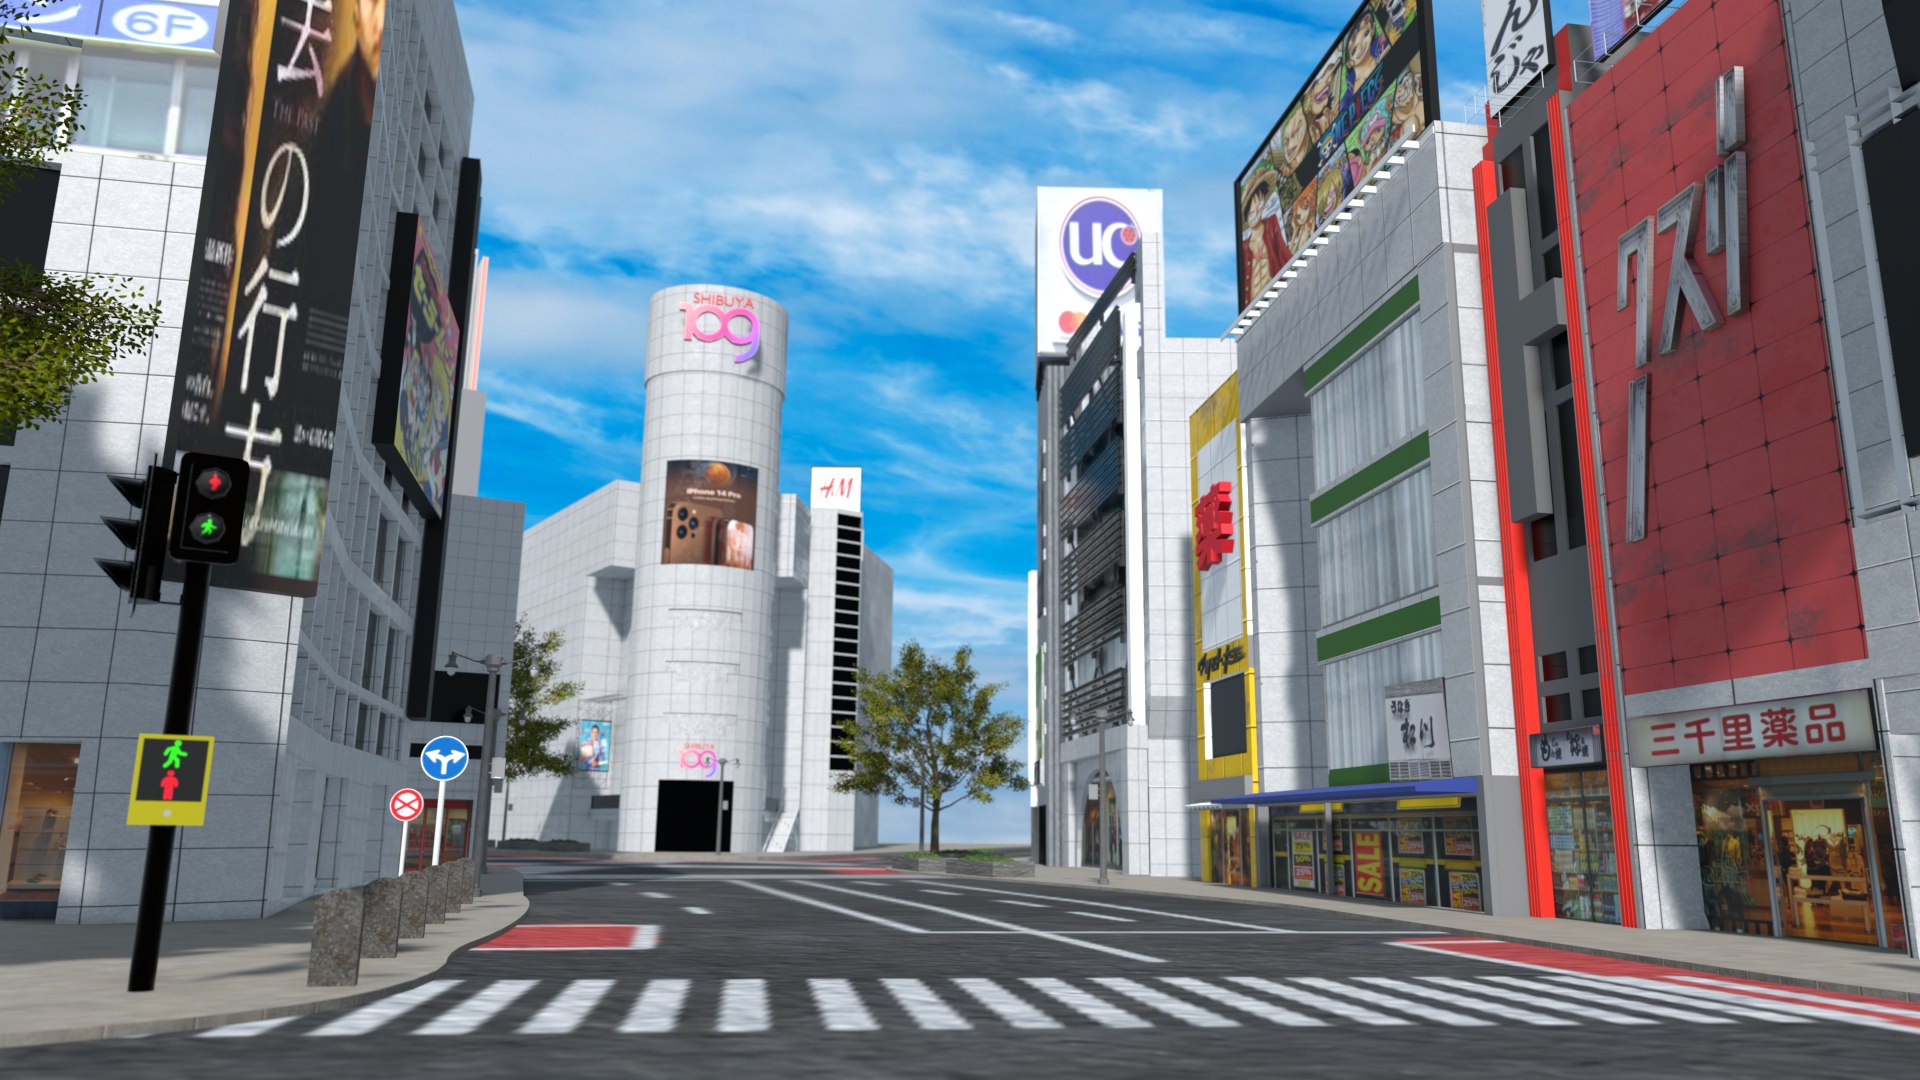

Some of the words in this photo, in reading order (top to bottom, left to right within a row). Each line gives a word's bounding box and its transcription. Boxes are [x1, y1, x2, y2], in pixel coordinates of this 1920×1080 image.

[125, 10, 196, 38] 6F
[693, 291, 755, 309] SHIBUYA
[679, 301, 761, 363] 109
[686, 487, 715, 496] iPhone
[716, 489, 727, 497] 14
[727, 490, 742, 499] Pro
[1650, 703, 1847, 757] 三千里薬品
[679, 750, 717, 778] 109
[1355, 832, 1383, 894] SALE
